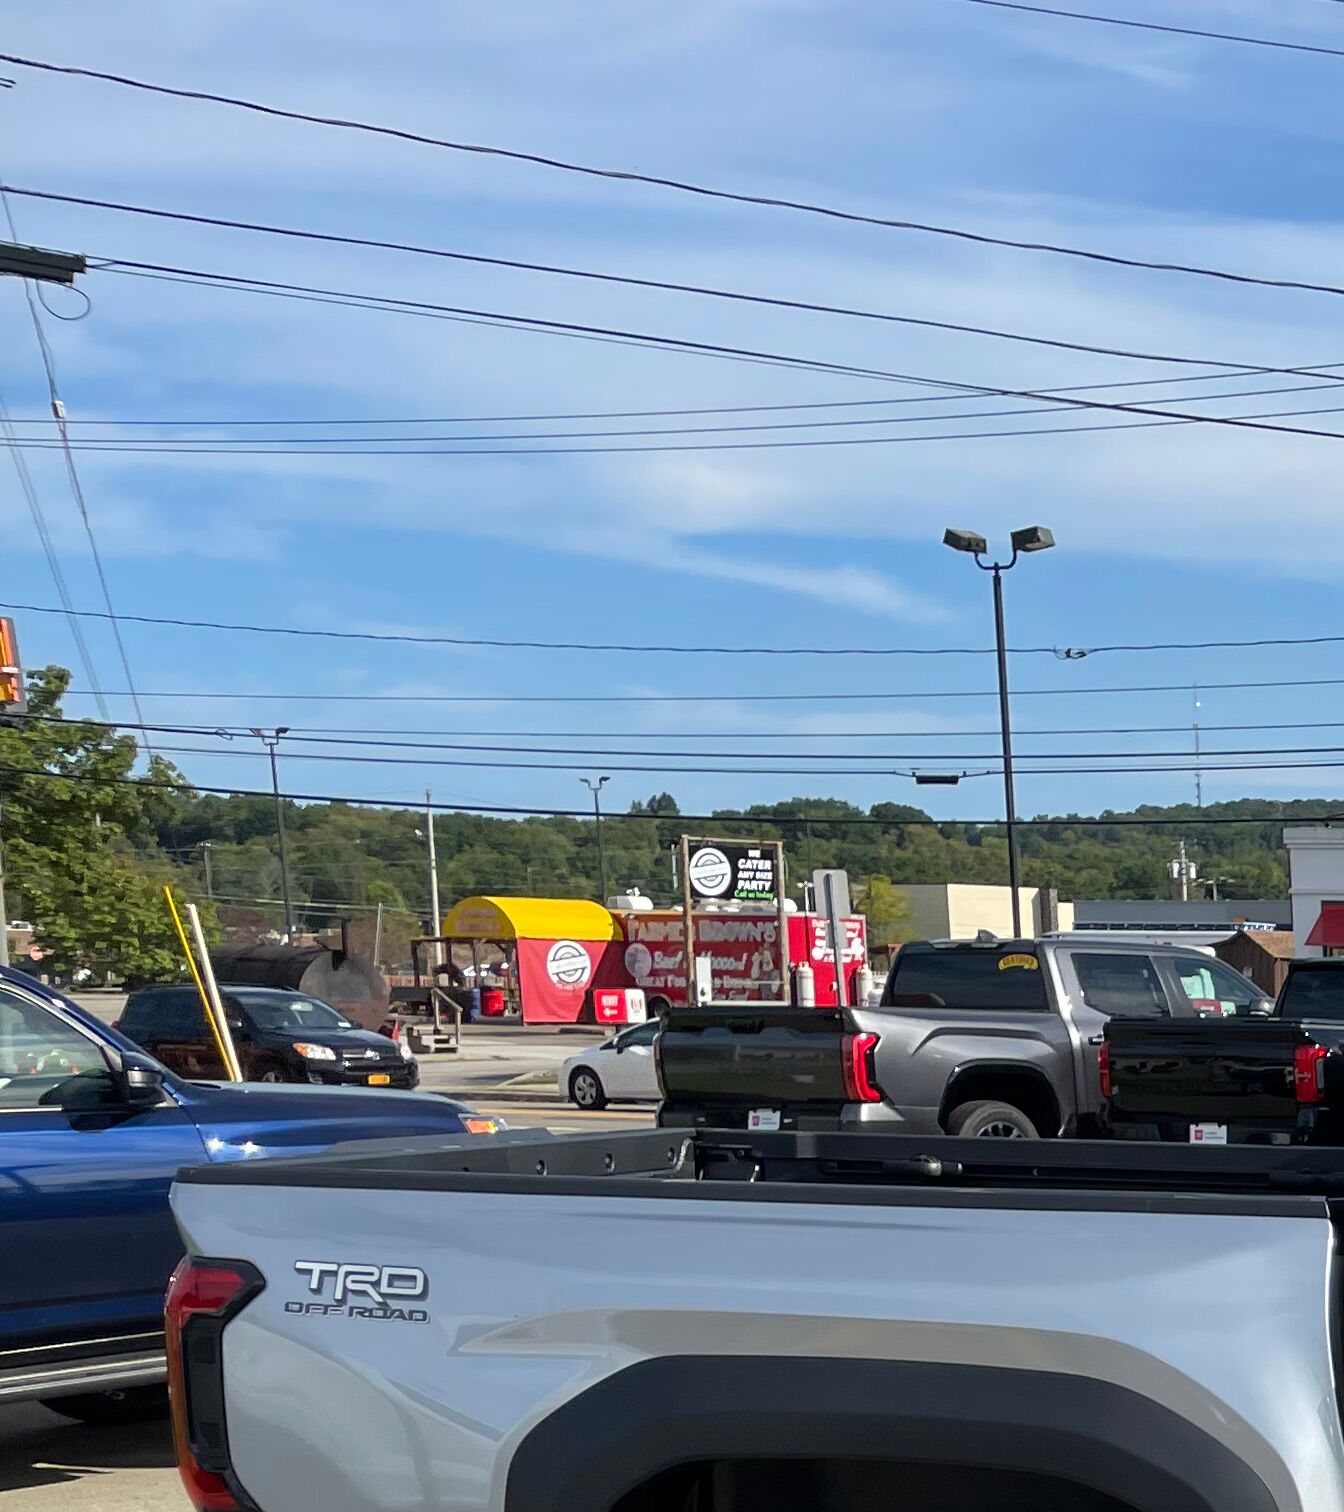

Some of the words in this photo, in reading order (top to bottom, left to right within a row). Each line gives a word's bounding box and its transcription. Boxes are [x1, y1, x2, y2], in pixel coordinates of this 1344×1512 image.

[738, 858, 772, 870] CATER
[738, 870, 755, 879] ANY
[737, 880, 772, 891] PARTY
[294, 1260, 427, 1304] TRD
[284, 1301, 344, 1316] OFF
[348, 1306, 430, 1324] ROAD
